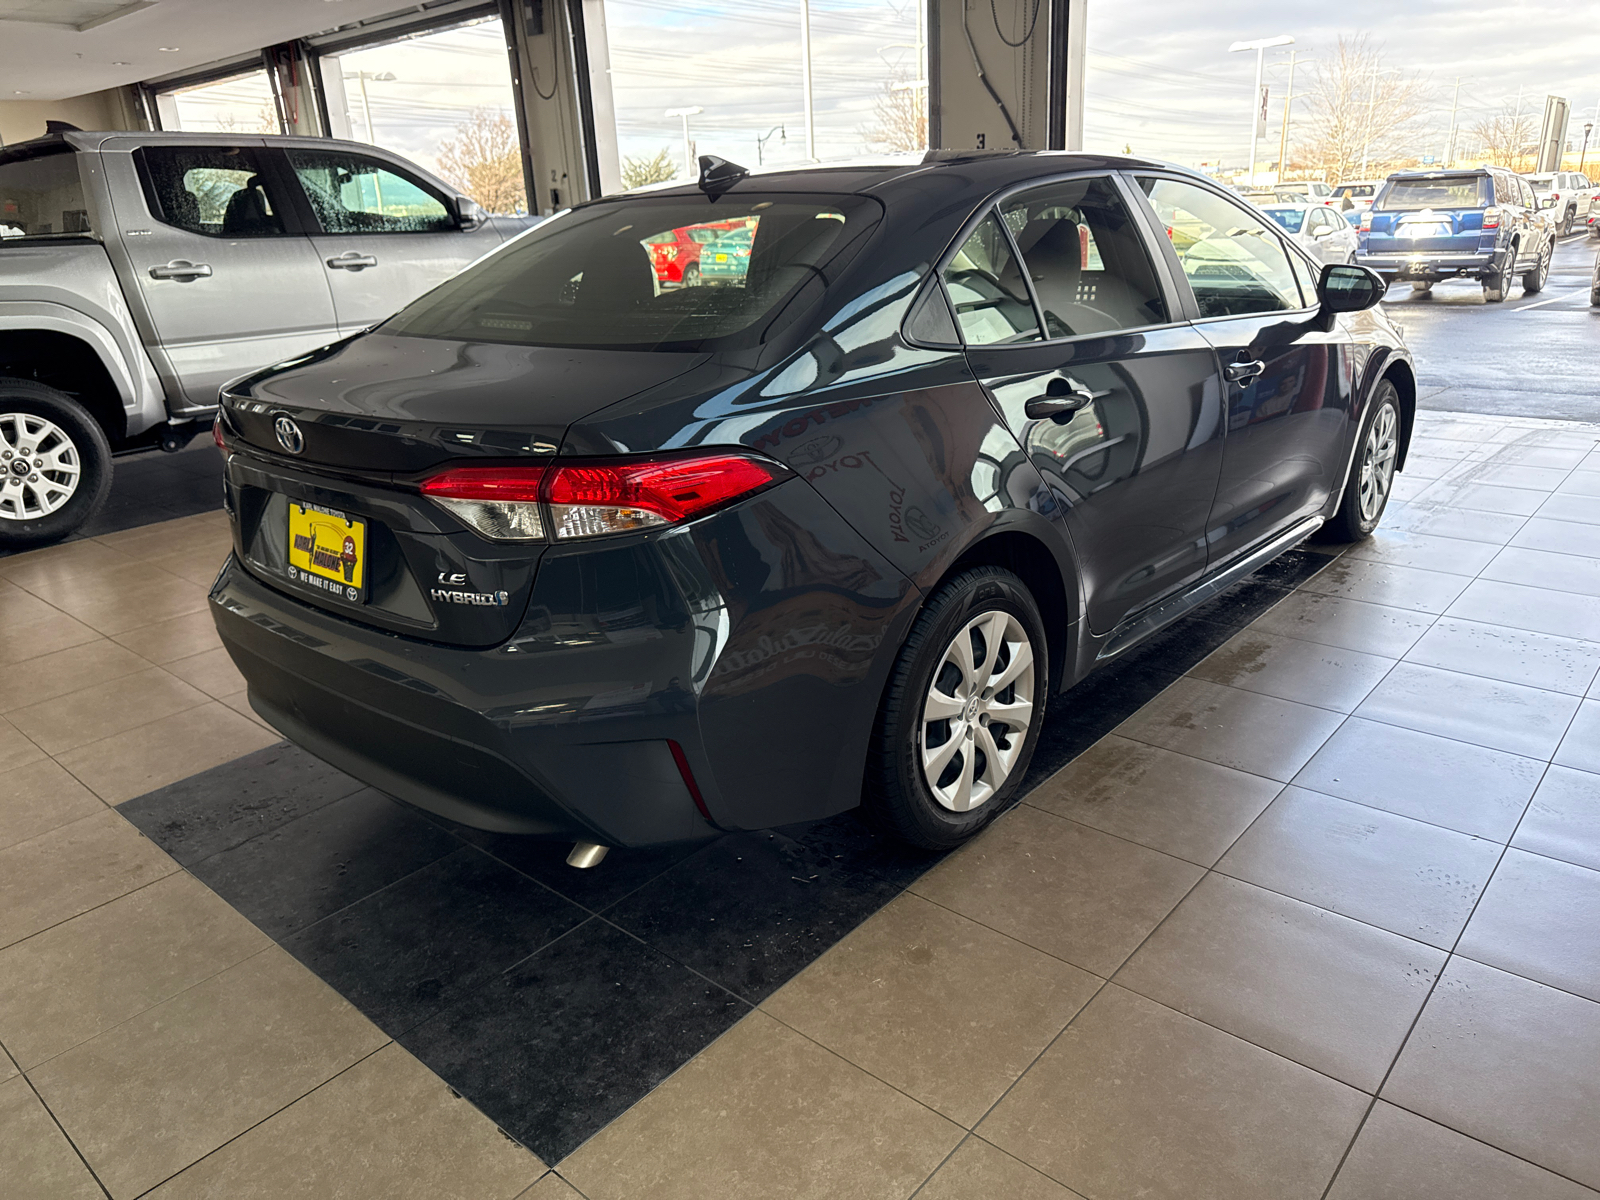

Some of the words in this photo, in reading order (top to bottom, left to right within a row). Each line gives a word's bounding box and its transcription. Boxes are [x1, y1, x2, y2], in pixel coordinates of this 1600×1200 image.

[976, 133, 986, 150] 3
[550, 169, 558, 183] 2
[889, 487, 911, 543] TOYOTA
[344, 541, 354, 555] 32
[313, 549, 342, 573] MALONE
[300, 571, 308, 581] WE
[308, 574, 323, 588] MAKE
[323, 579, 329, 590] IT
[329, 581, 344, 595] EASY
[438, 572, 467, 586] LE
[430, 589, 494, 606] HYBRID
